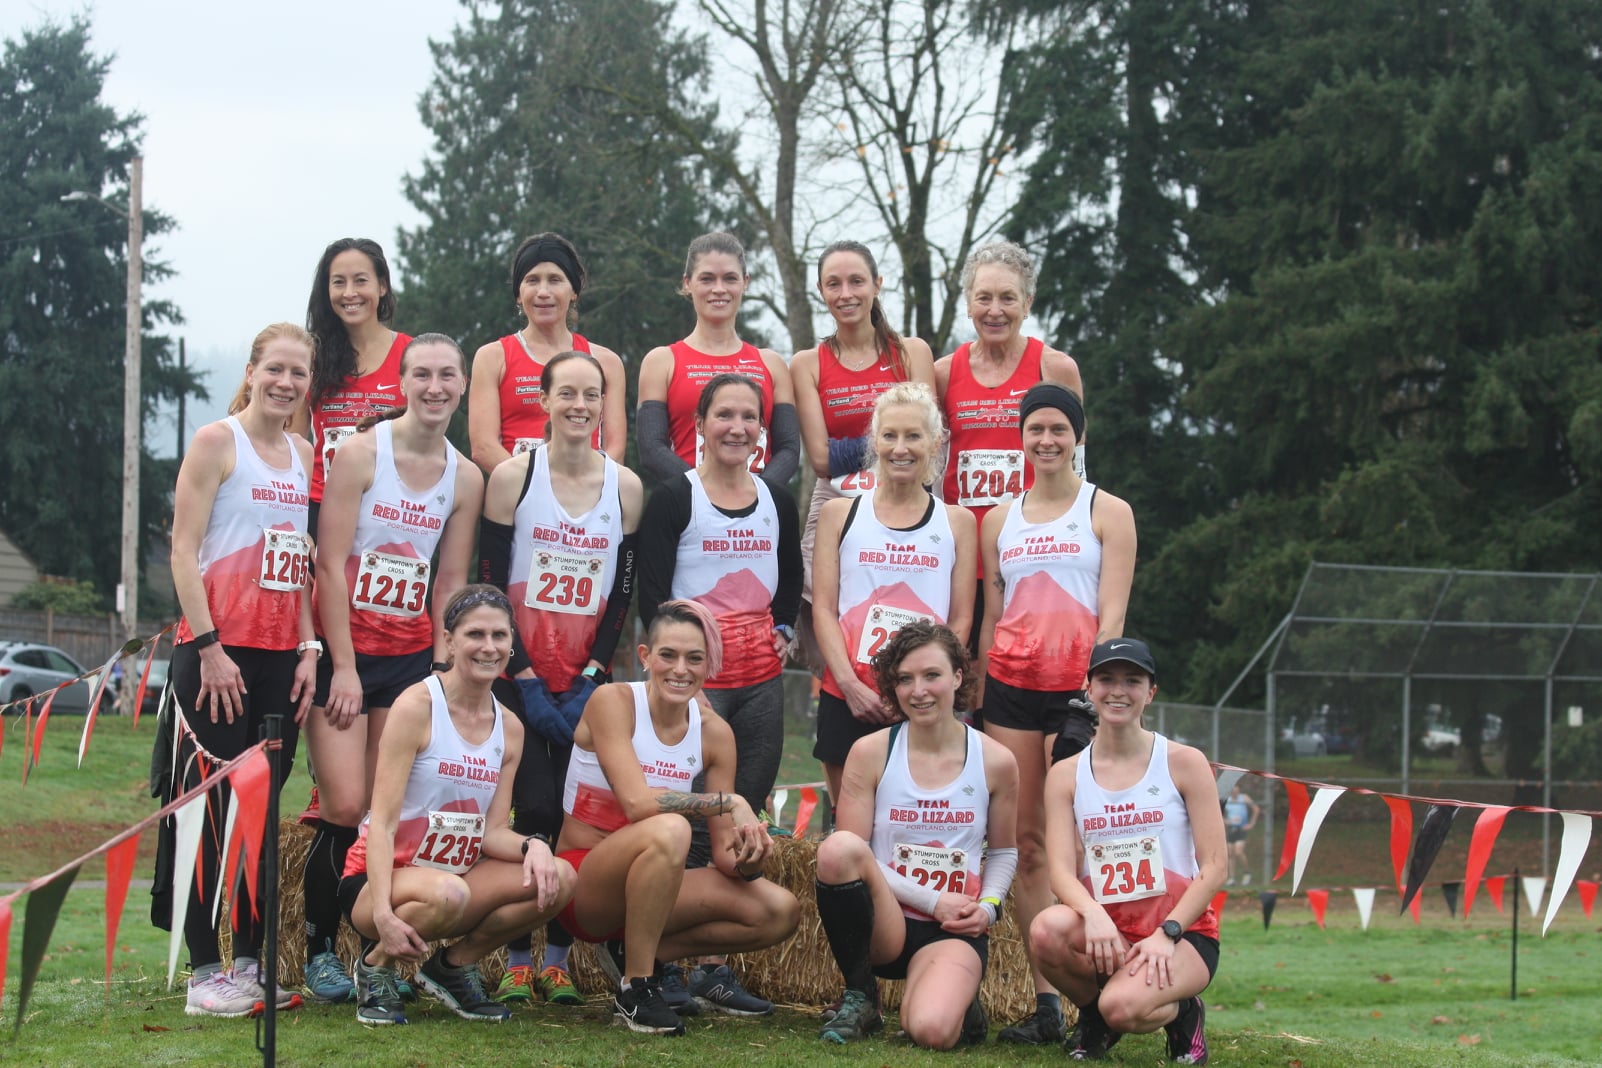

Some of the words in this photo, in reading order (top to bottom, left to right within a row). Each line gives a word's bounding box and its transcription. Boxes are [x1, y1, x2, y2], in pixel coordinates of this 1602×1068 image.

[828, 398, 850, 406] Portland
[973, 453, 1005, 461] STUMPTOWN
[271, 480, 296, 491] TEAM
[959, 469, 1023, 499] 1204
[252, 487, 277, 501] RED
[400, 499, 426, 513] TEAM
[372, 504, 400, 521] RED
[402, 511, 442, 530] LIZARD
[532, 526, 559, 543] RED
[562, 532, 609, 550] LIZARD
[726, 529, 754, 538] TEAM
[1024, 535, 1055, 544] TEAM
[702, 540, 730, 552] RED
[733, 540, 772, 552] LIZARD
[885, 543, 916, 552] TEAM
[1002, 546, 1024, 563] RED
[1026, 543, 1081, 556] LIZARD
[381, 557, 414, 569] STUMPTOWN
[553, 556, 588, 566] STUMPTOWN
[859, 551, 887, 563] RED
[889, 554, 939, 569] LIZARD
[264, 549, 308, 587] 1265
[387, 566, 405, 575] CROSS
[560, 565, 579, 573] CROSS
[355, 572, 426, 612] 1213
[536, 572, 593, 608] 239
[462, 754, 487, 767] TEAM
[655, 760, 676, 769] TEAM
[438, 762, 465, 777] RED
[657, 768, 691, 780] LIZARD
[916, 799, 950, 809] TEAM
[1103, 802, 1135, 814] TEAM
[446, 816, 474, 824] STUMPTOWN
[889, 808, 919, 823] RED
[922, 811, 975, 824] LIZARD
[1083, 816, 1107, 832] RED
[1110, 810, 1164, 828] LIZARD
[906, 824, 946, 832] PORTLAND,
[1098, 828, 1136, 838] PORTLAND,
[417, 832, 482, 867] 1235
[1105, 842, 1138, 852] STUMPTOWN
[913, 849, 949, 860] STUMPTOWN
[1113, 851, 1132, 859] CROSS
[1100, 858, 1156, 897] 234
